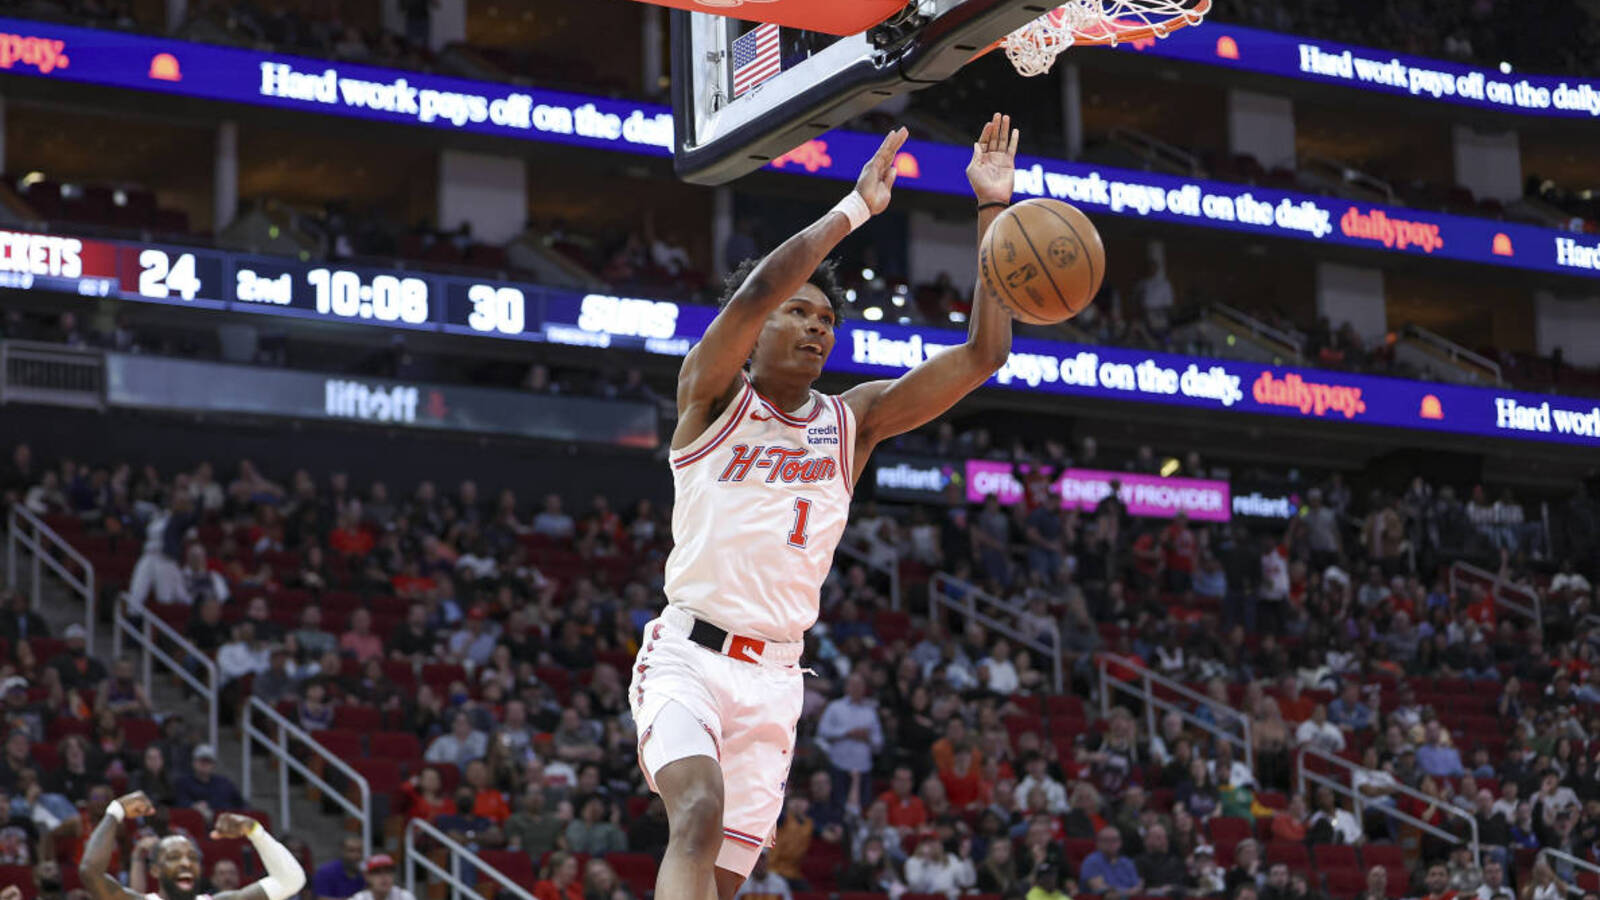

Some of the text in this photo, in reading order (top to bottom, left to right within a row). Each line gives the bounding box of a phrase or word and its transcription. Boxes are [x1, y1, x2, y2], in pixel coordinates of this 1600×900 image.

[1299, 44, 1352, 79] Hard
[1352, 59, 1408, 88] work
[1408, 68, 1456, 98] pays
[1456, 73, 1485, 101] off
[1486, 82, 1513, 105] on
[1512, 81, 1550, 108] the
[260, 61, 675, 153] Hard work pays off on the dail
[1044, 172, 1110, 205] work
[1109, 181, 1166, 215] pays
[1166, 185, 1201, 217] off
[1202, 195, 1236, 221] on
[1235, 193, 1275, 226] the
[1274, 198, 1332, 238] daily.
[1340, 206, 1443, 253] dailypay.
[139, 249, 201, 300] 24
[236, 268, 429, 324] 2nd 10:08
[468, 284, 525, 335] 30
[851, 329, 924, 368] Hard
[324, 378, 419, 424] liftoff
[1060, 352, 1098, 387] off
[1099, 360, 1136, 391] on
[1135, 359, 1179, 395] the
[1180, 364, 1243, 406] daily.
[1253, 370, 1366, 418] dailypay.
[808, 426, 837, 435] credit
[1495, 397, 1552, 432] Hard
[718, 444, 837, 483] H-Town
[808, 436, 838, 445] karma
[876, 463, 942, 492] reliant
[787, 497, 812, 549] 1
[1232, 491, 1289, 519] reliant
